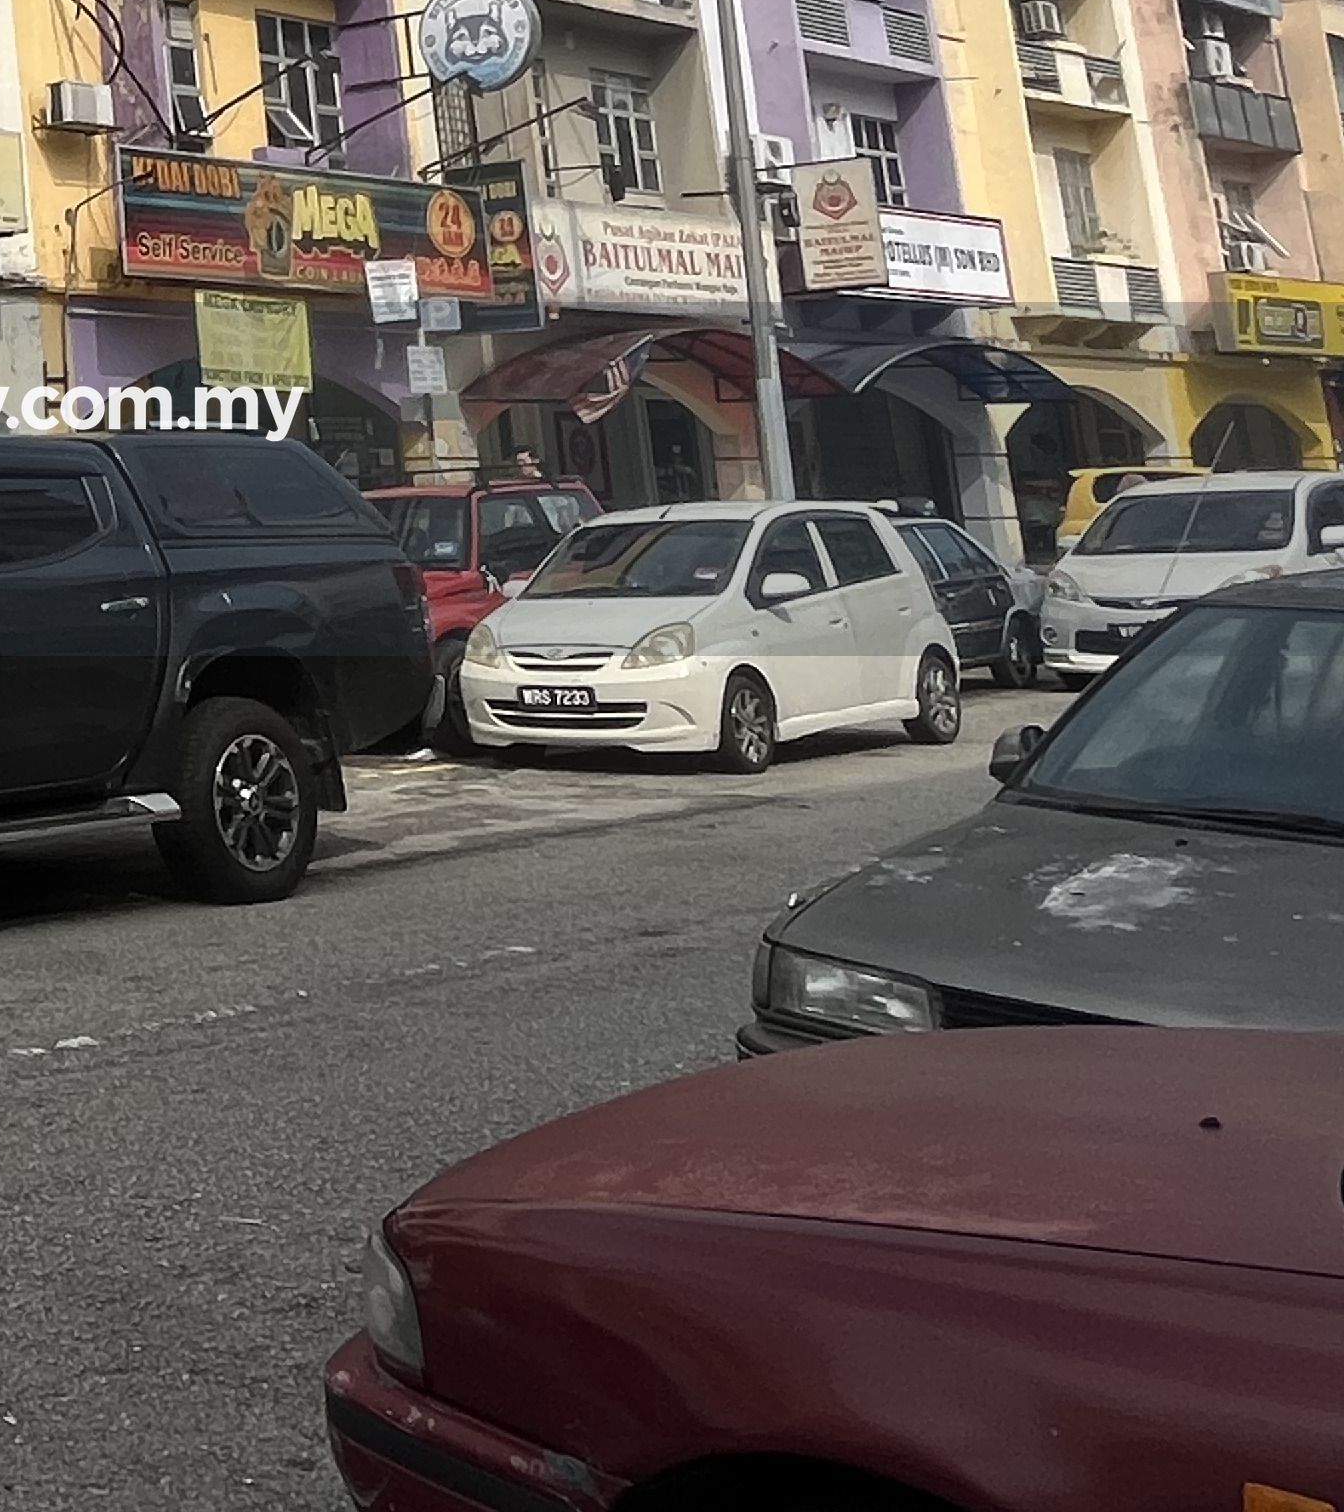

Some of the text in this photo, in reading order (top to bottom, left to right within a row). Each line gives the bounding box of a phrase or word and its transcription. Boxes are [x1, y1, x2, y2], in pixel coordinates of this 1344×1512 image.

[292, 186, 380, 249] MEGA
[438, 202, 463, 230] 24
[137, 231, 245, 264] Self Service
[582, 240, 743, 279] BAITULMAL MAI
